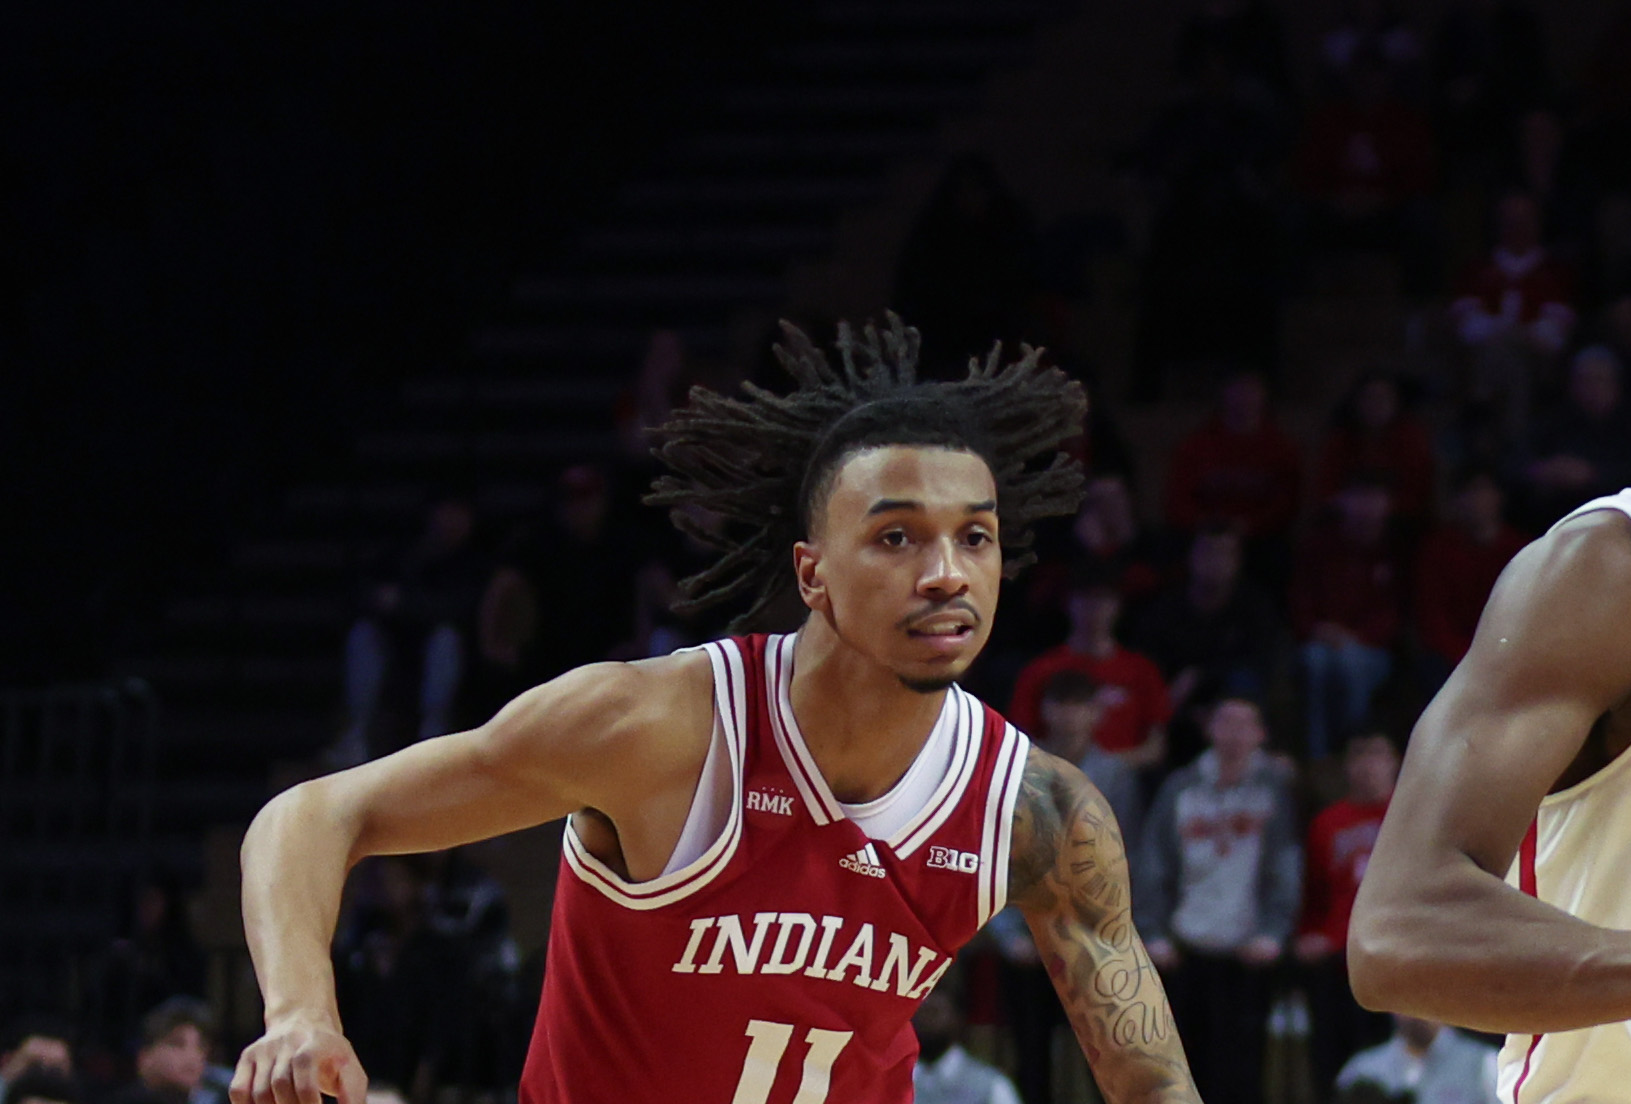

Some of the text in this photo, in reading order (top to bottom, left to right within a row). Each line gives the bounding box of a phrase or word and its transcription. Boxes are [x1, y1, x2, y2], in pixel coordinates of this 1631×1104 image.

[746, 790, 795, 816] RMK
[838, 856, 886, 879] adidas
[671, 912, 953, 1000] INDIANA
